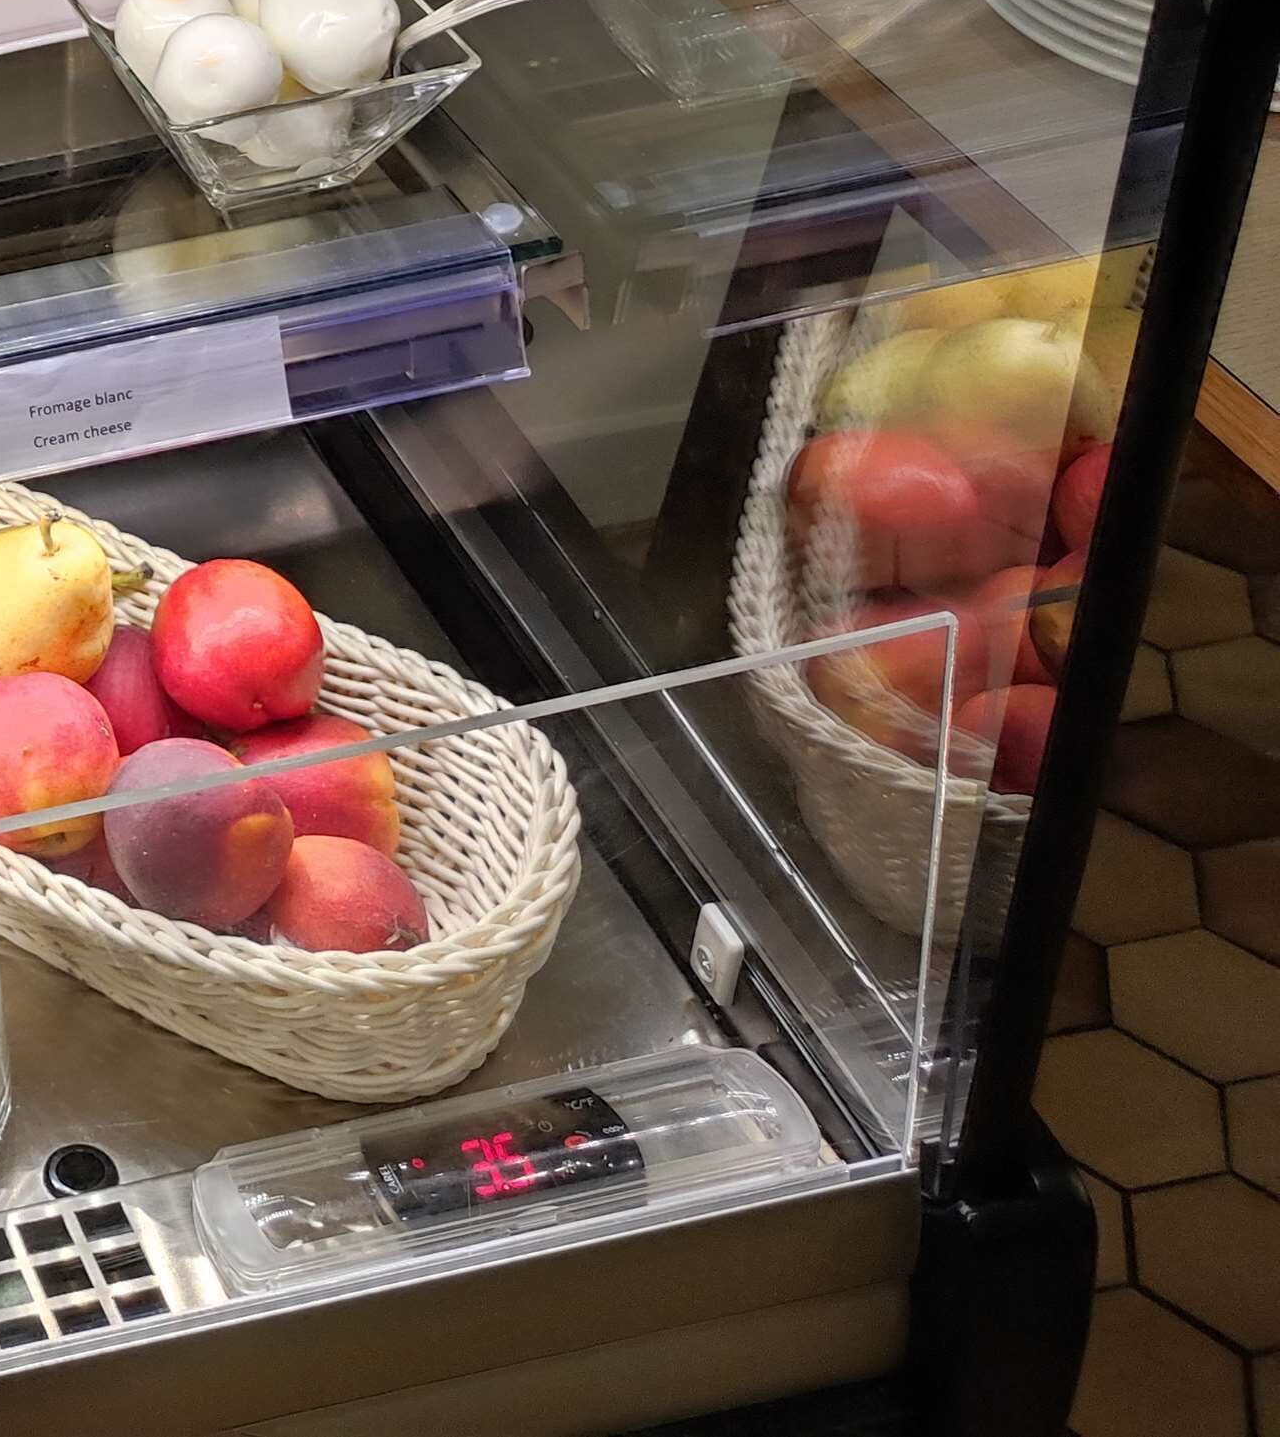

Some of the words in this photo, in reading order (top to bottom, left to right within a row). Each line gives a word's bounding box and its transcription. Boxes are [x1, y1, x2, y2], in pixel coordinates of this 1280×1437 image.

[29, 395, 91, 418] Fromage
[95, 388, 133, 405] blanc
[33, 431, 80, 449] Cream
[83, 419, 132, 439] cheese
